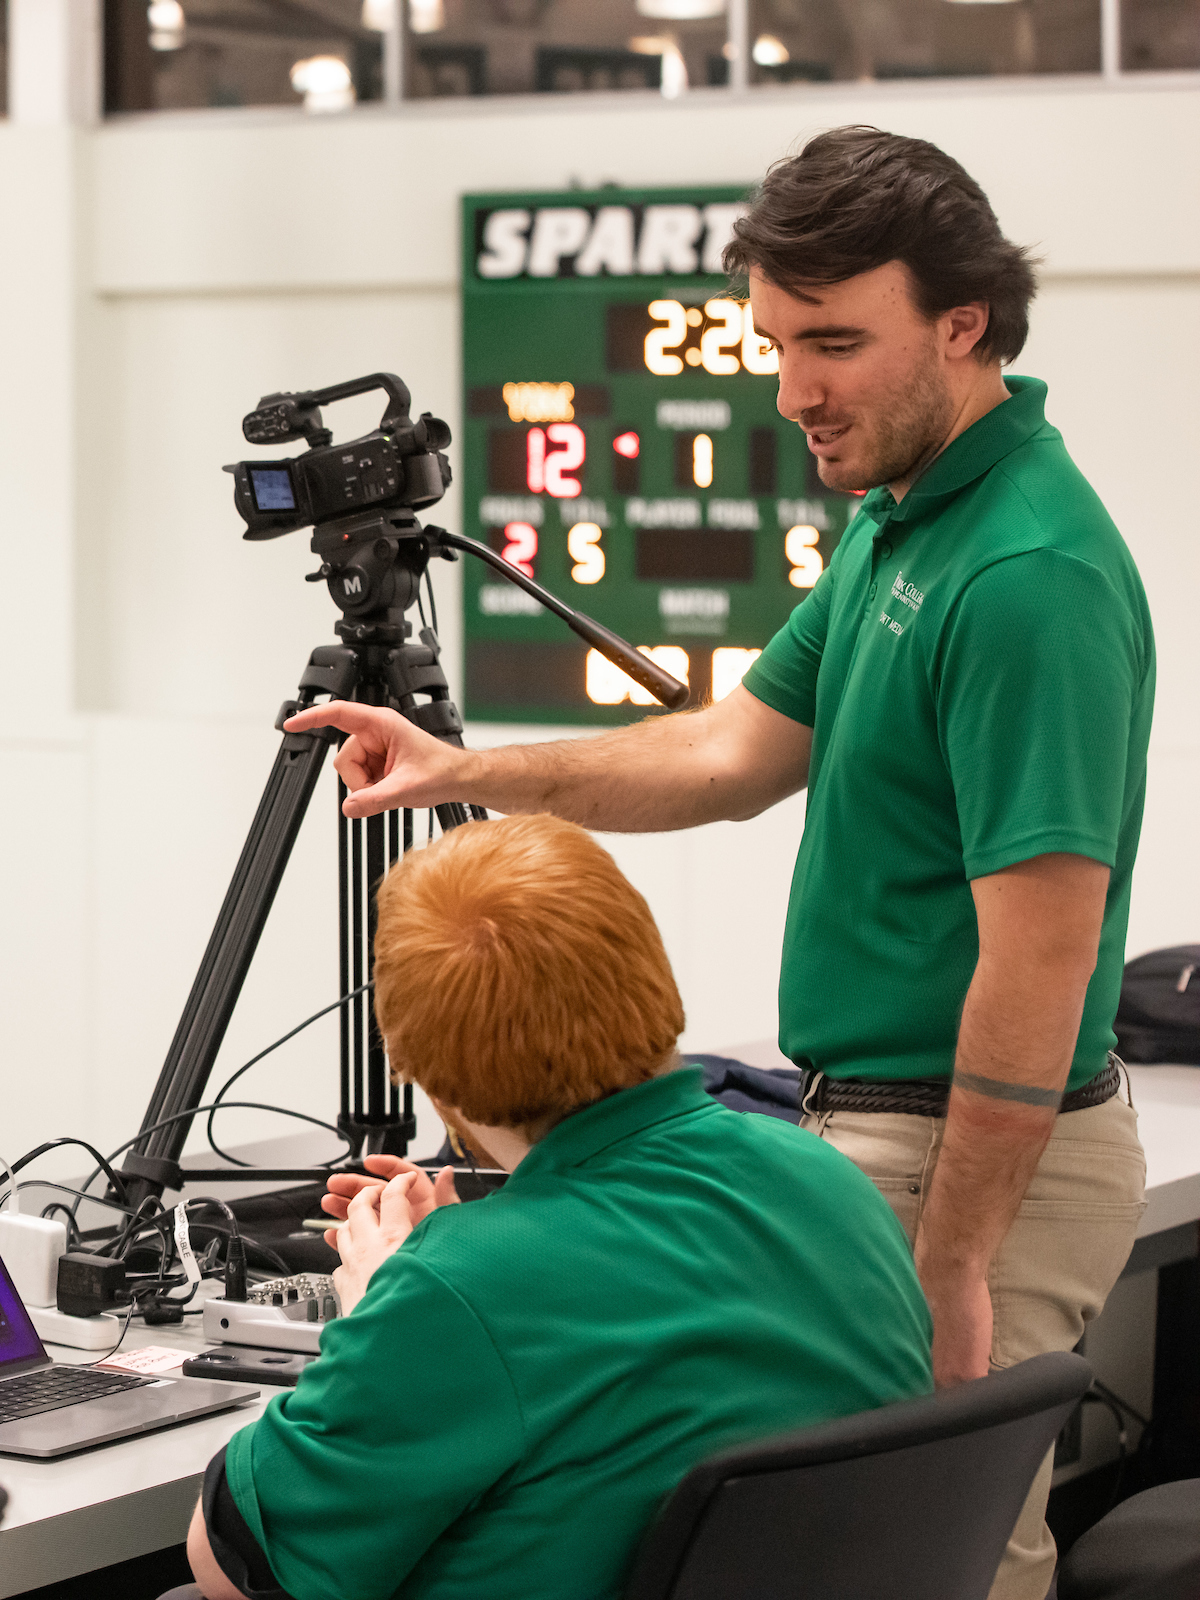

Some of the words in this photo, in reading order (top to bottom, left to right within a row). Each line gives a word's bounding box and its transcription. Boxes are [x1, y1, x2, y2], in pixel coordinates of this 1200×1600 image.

[527, 423, 586, 498] 12
[692, 433, 713, 488] 1
[567, 522, 606, 584] 5
[785, 525, 824, 588] 5
[343, 576, 362, 595] M
[178, 1231, 191, 1258] CABLE
